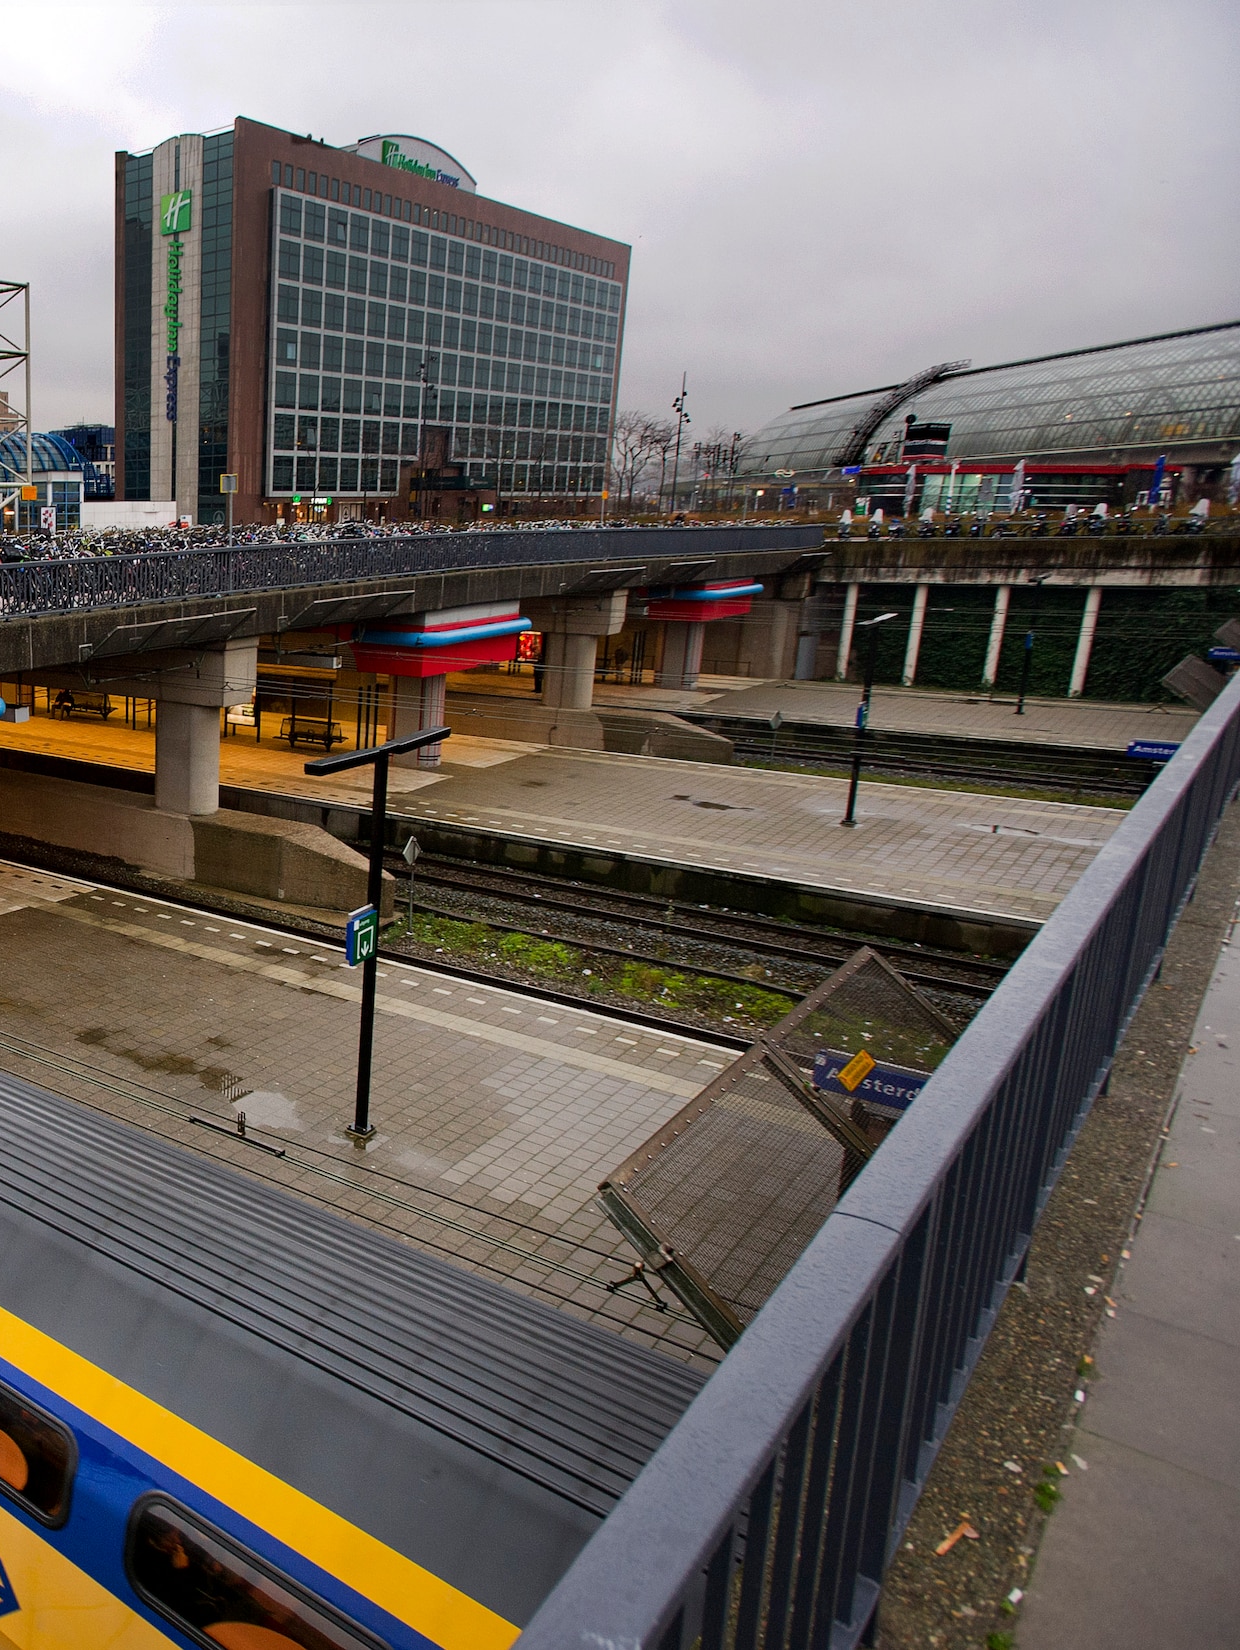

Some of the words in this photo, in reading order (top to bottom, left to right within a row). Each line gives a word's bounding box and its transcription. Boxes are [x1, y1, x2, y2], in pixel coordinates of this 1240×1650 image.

[164, 241, 184, 318] Holiday
[167, 321, 183, 352] Inn
[163, 355, 181, 421] Express
[826, 1067, 921, 1101] Asterd
